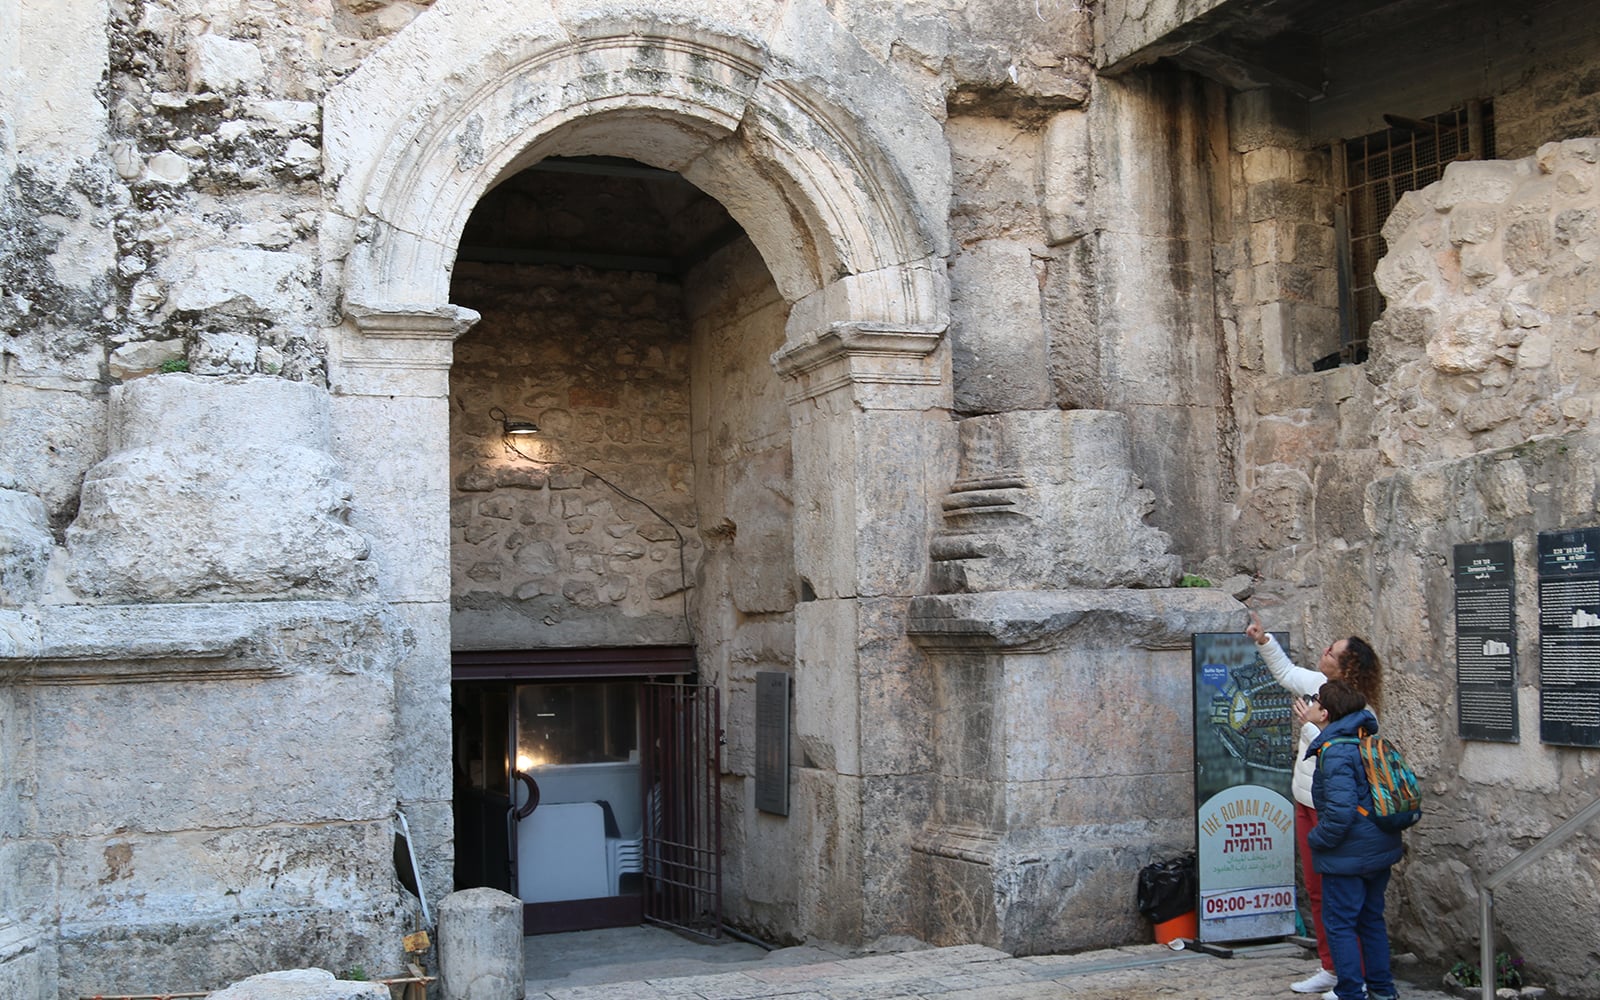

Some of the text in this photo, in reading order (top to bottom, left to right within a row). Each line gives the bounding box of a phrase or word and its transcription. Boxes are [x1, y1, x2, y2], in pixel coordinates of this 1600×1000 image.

[1201, 799, 1293, 837] THE ROMAN PLAZA
[1226, 822, 1266, 838] הכיכר
[1223, 837, 1273, 853] הרומית
[1206, 892, 1292, 913] 09:00-17:00
